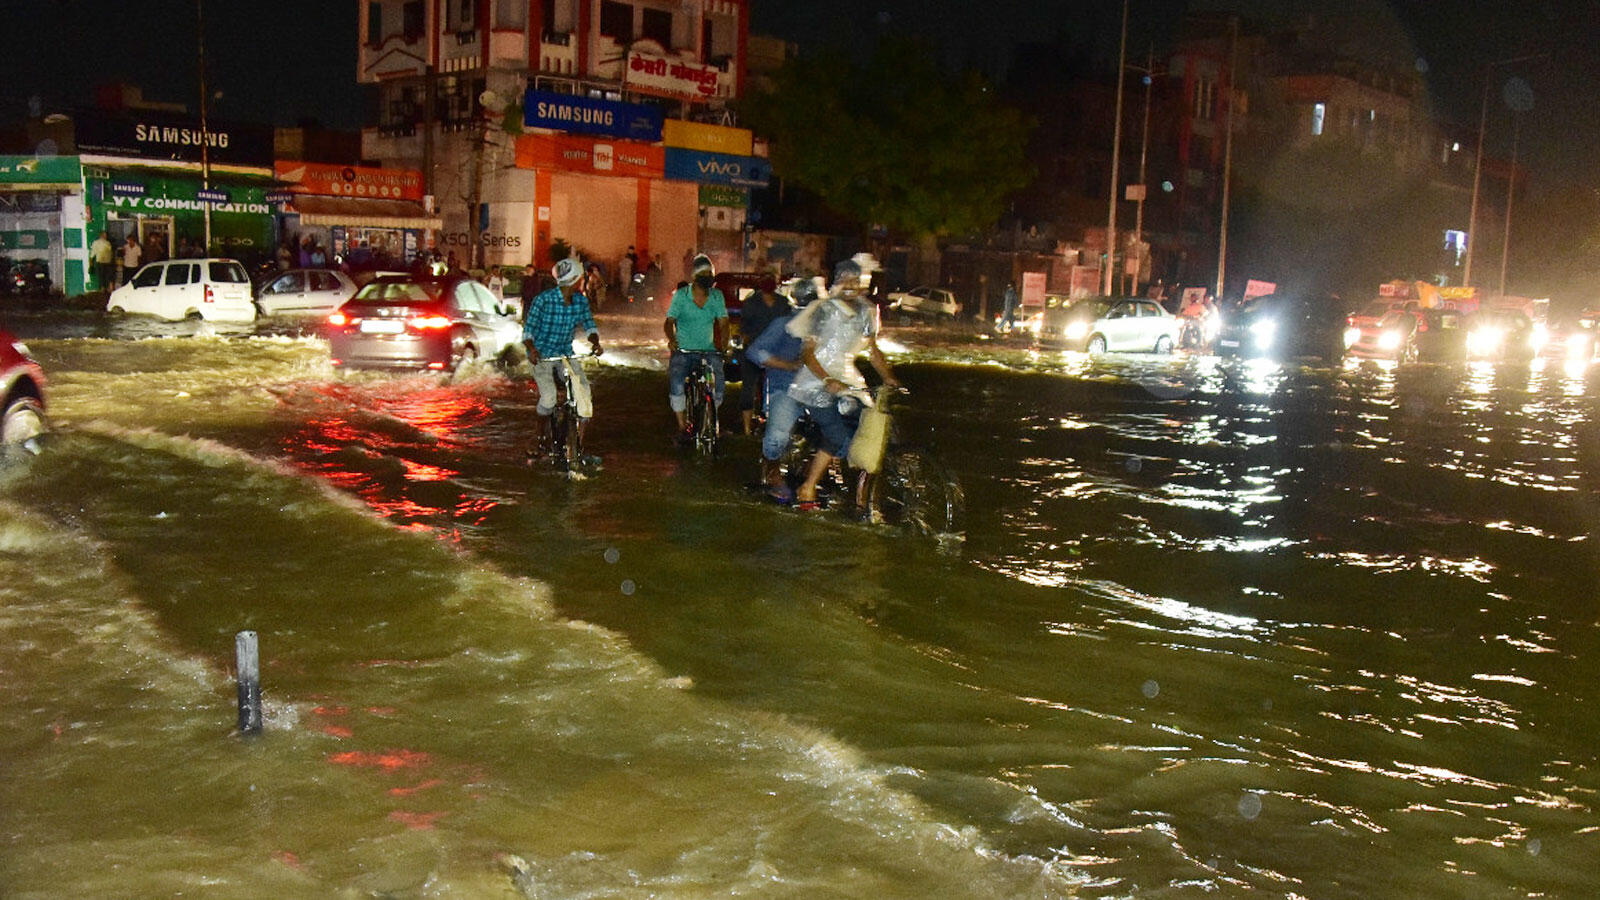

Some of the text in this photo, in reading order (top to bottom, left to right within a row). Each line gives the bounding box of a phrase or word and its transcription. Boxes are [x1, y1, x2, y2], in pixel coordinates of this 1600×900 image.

[537, 102, 614, 126] SAMSUNG
[136, 124, 229, 148] SAMSUNG
[482, 232, 521, 247] Series
